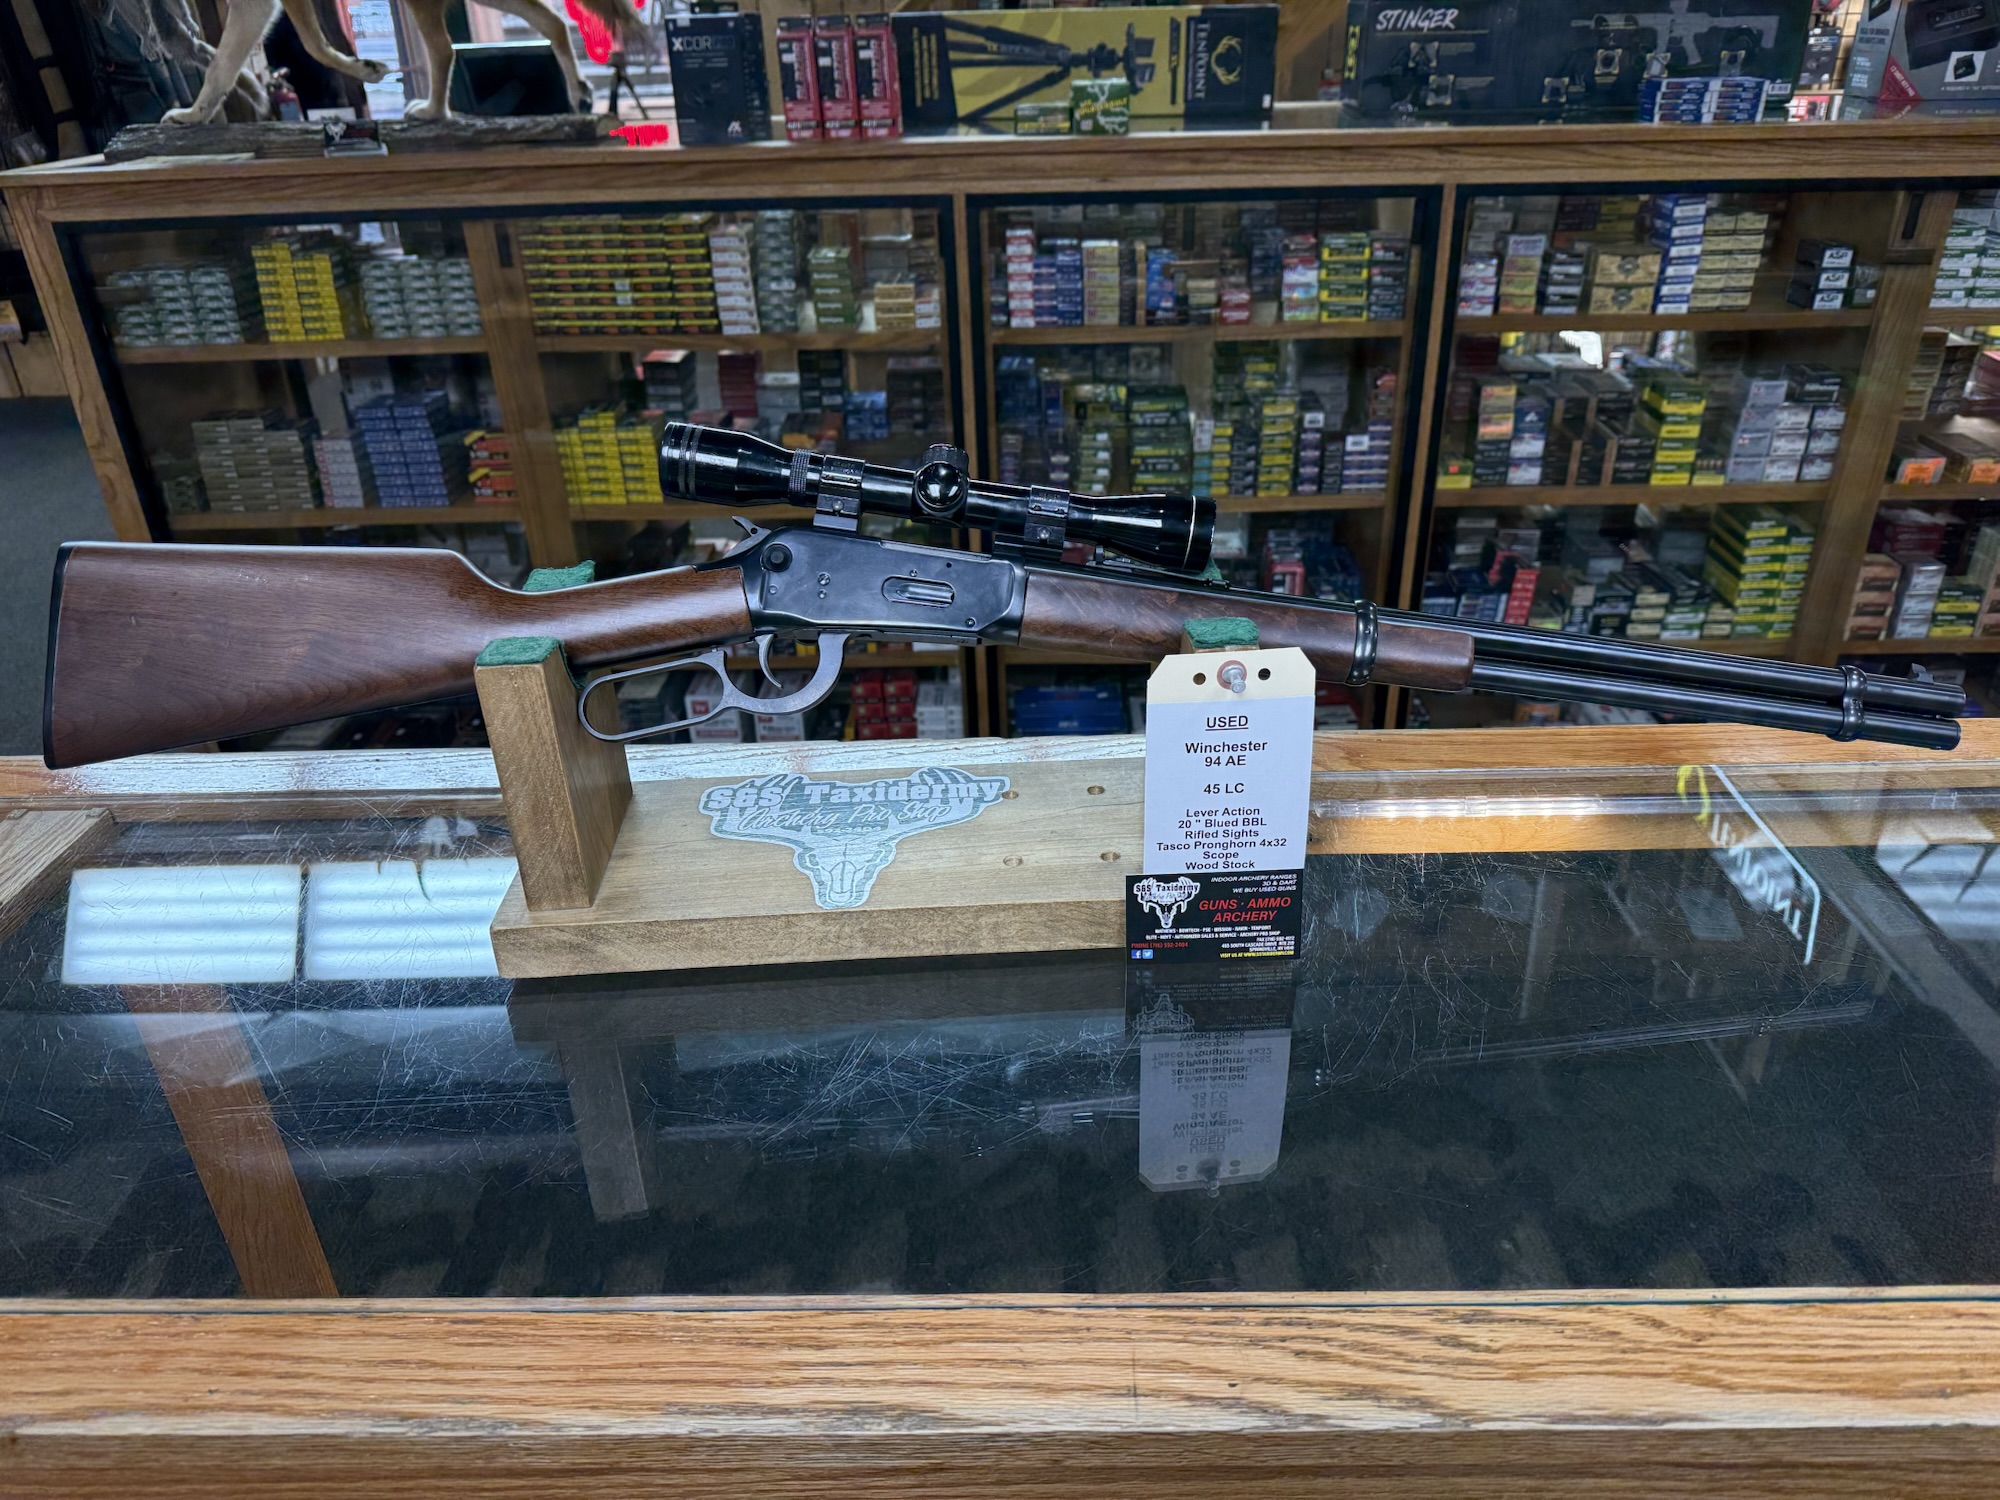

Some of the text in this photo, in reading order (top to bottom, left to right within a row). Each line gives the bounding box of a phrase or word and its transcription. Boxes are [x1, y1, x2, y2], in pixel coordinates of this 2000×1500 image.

[1375, 8, 1460, 33] STINGER
[1206, 715, 1249, 728] USED
[1185, 740, 1268, 754] Winchester
[1204, 755, 1247, 767] 94 AE
[806, 780, 1002, 804] Taxidermy
[1203, 782, 1245, 795] 45 LC
[737, 801, 952, 832] Archery Pro Shop
[1186, 807, 1260, 818] Lever Action
[1178, 820, 1192, 829] 20
[1204, 818, 1238, 828] Blued
[1242, 818, 1268, 827] BBL
[1185, 828, 1260, 840] Rifled Sights
[1156, 838, 1287, 852] Tasco Pronghorn 4x32
[1202, 850, 1240, 862] Scope
[1186, 860, 1256, 871] Wood Stock
[1156, 884, 1199, 893] Taxidermy
[1198, 896, 1292, 911] GUNS AMMO
[1212, 910, 1278, 922] ARCHERY
